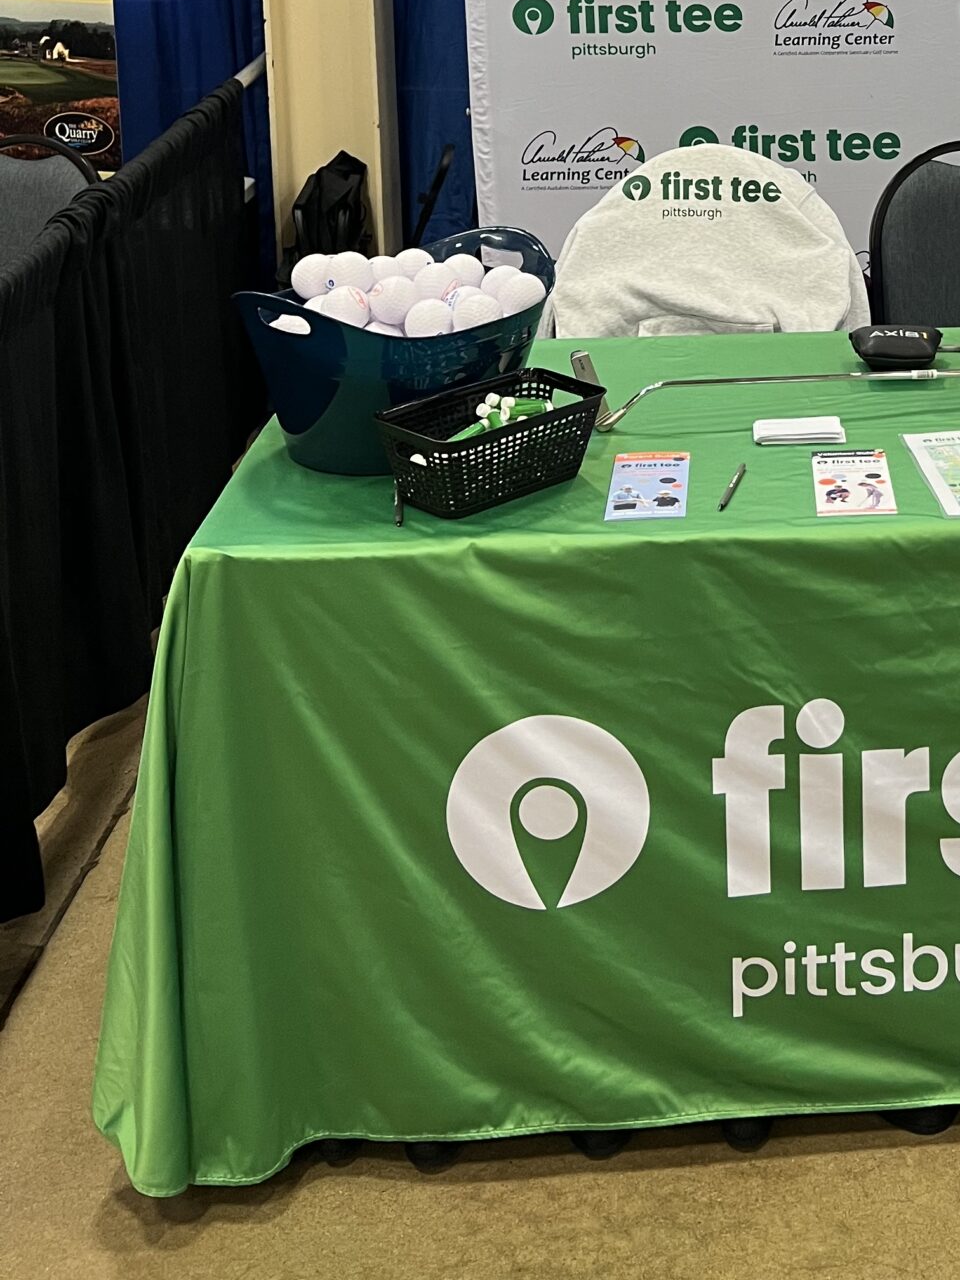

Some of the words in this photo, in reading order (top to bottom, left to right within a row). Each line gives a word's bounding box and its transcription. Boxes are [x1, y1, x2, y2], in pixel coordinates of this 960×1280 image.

[665, 0, 743, 33] tee
[775, 33, 841, 49] Learning
[845, 33, 895, 45] Center
[572, 42, 656, 60] pittsburgh
[55, 122, 98, 142] Quarry
[732, 125, 815, 161] first
[826, 129, 901, 161] tee
[523, 168, 591, 184] Learning
[595, 168, 629, 180] Cent
[661, 171, 723, 201] first
[731, 177, 782, 203] tee
[662, 207, 722, 220] pittsburgh
